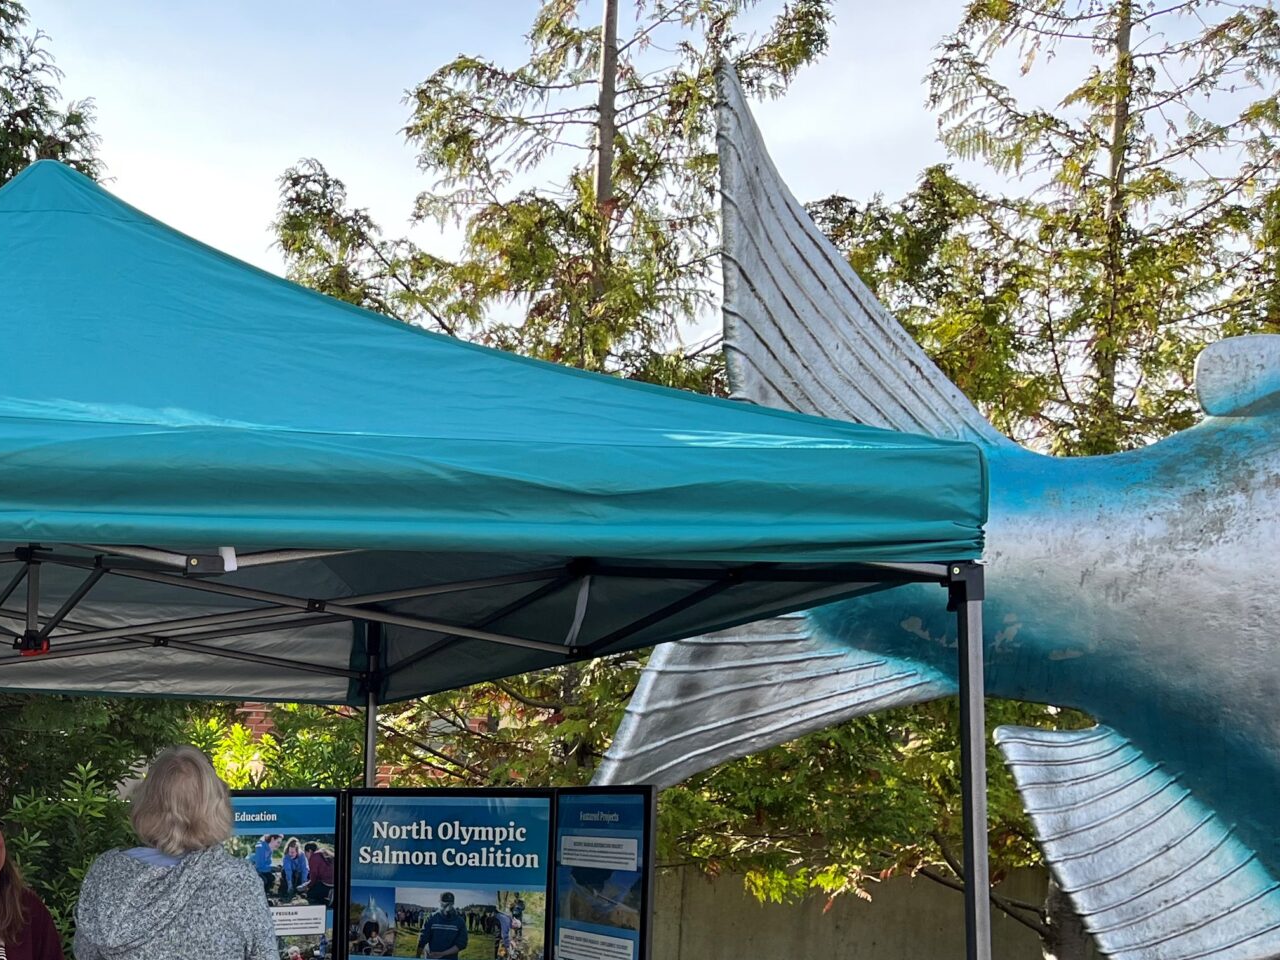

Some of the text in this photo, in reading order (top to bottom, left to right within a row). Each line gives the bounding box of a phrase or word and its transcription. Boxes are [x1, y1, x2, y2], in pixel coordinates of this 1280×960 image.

[234, 811, 277, 822] Education
[373, 820, 527, 846] North Olympic
[358, 845, 437, 866] Salmon
[441, 847, 539, 869] Coalition
